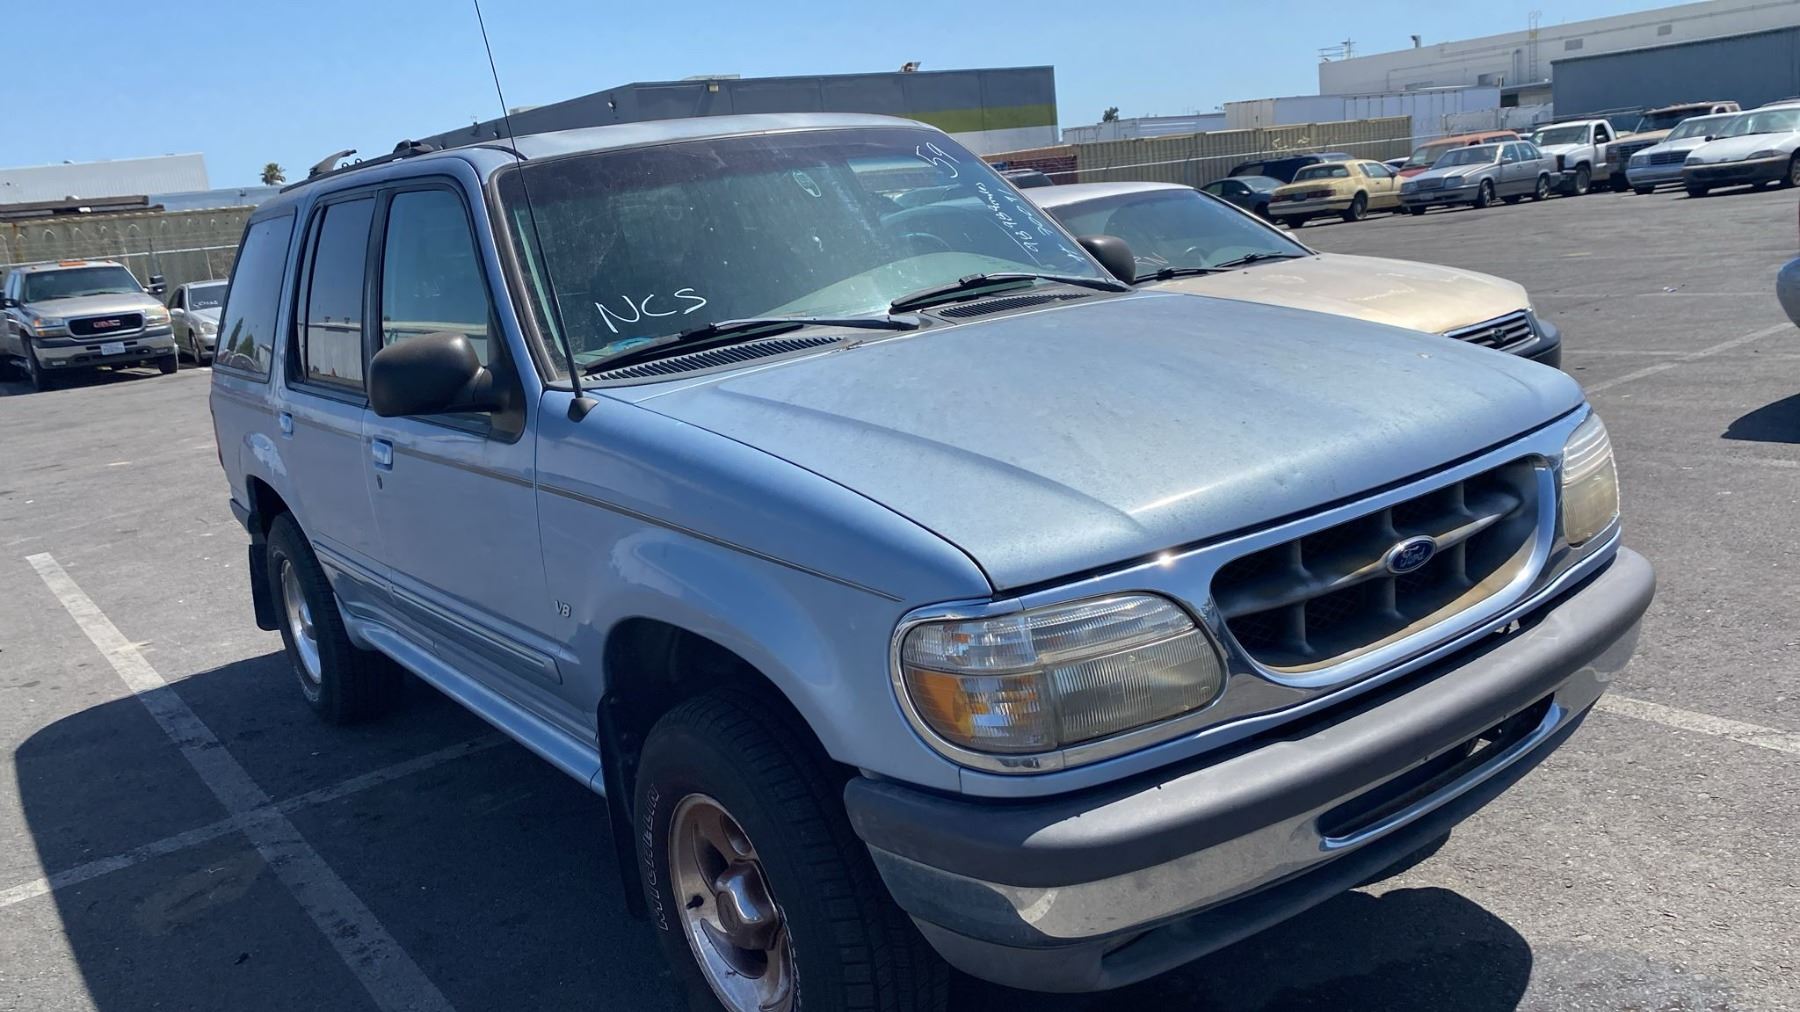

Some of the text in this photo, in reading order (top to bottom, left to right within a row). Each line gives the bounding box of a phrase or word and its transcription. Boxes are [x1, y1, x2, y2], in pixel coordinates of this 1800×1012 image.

[916, 142, 960, 179] 59
[93, 319, 121, 329] GMC
[595, 288, 707, 333] NCS
[1392, 542, 1429, 570] Ford
[555, 600, 571, 618] V8
